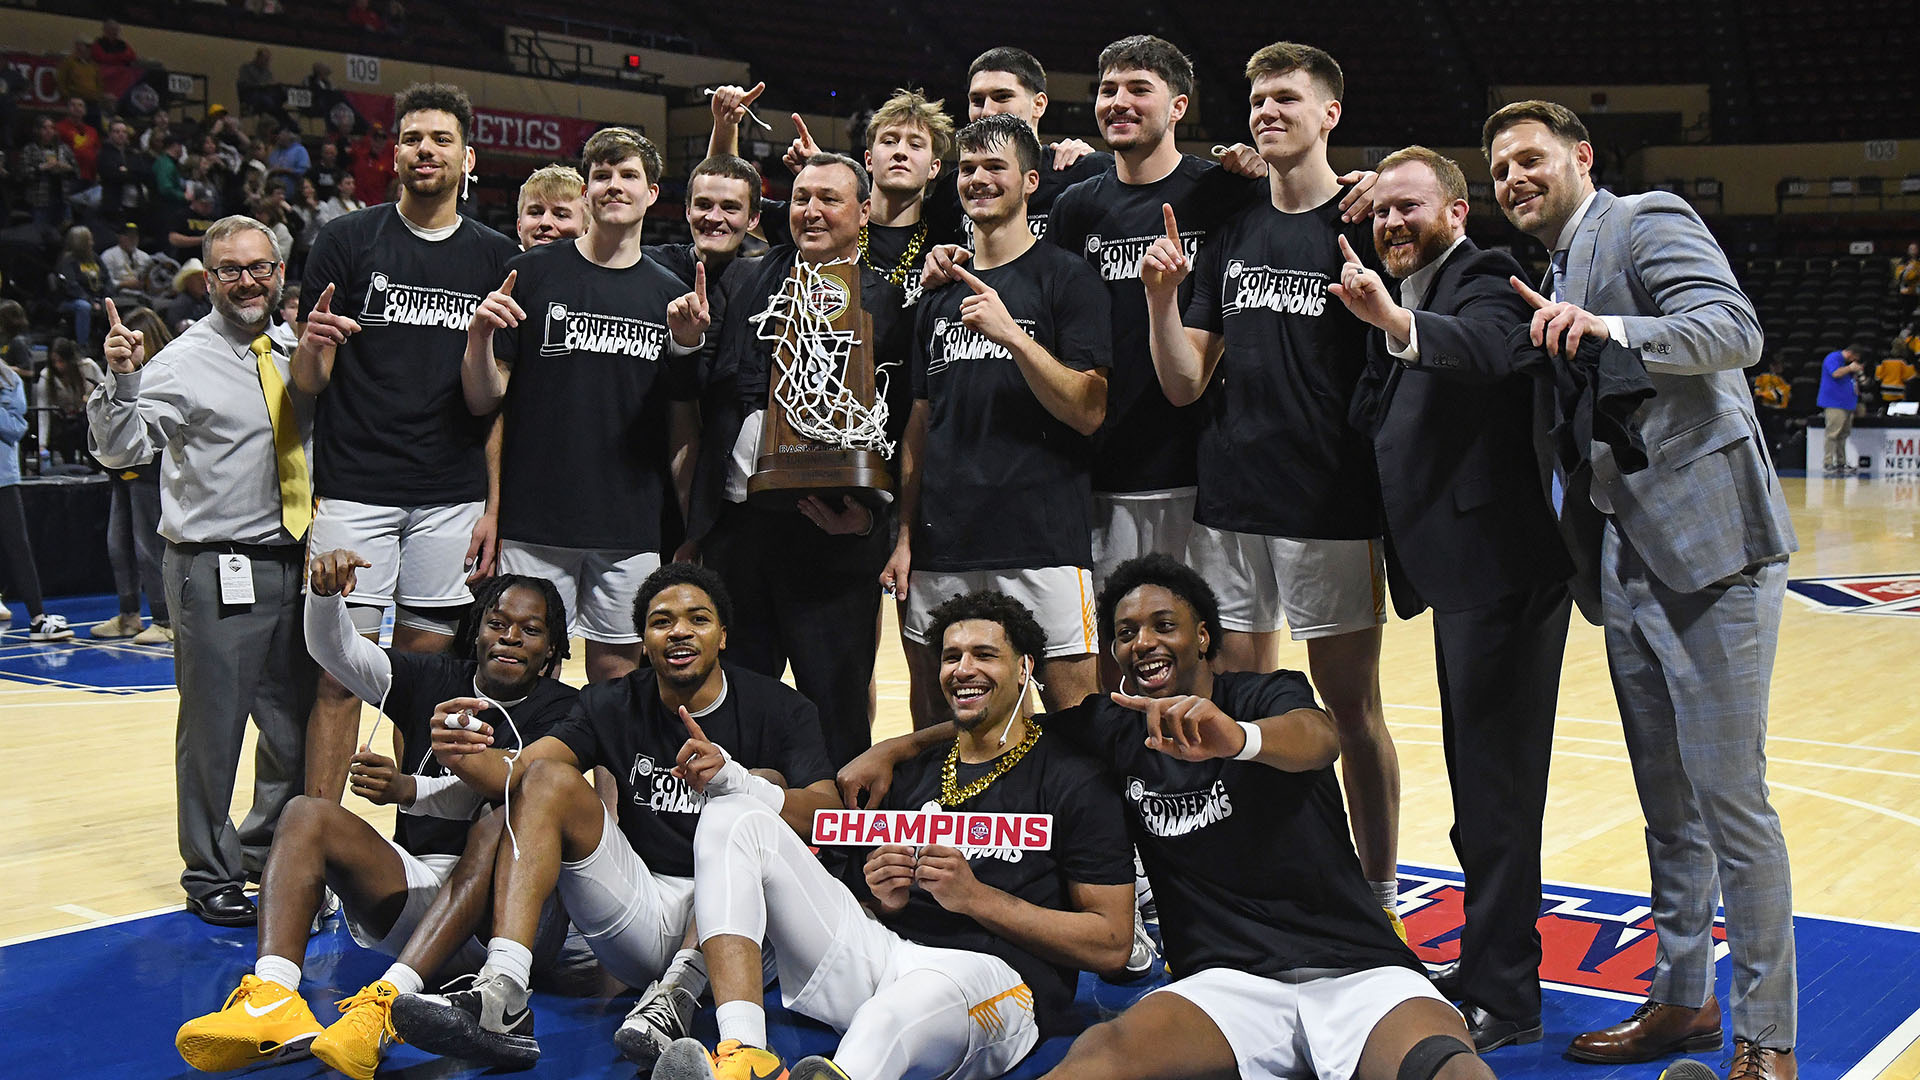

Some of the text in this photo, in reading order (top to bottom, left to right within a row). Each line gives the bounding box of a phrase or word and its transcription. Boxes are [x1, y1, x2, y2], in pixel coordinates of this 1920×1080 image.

[349, 59, 377, 80] 109
[469, 113, 562, 150] ETICS
[386, 288, 480, 314] CONFERENC
[384, 306, 472, 331] CHAMPION
[566, 317, 664, 344] CONFERENCE
[564, 332, 662, 361] CHAMPIONS
[943, 340, 1013, 363] CHAMPIO
[815, 812, 1049, 848] CHAMPIONS
